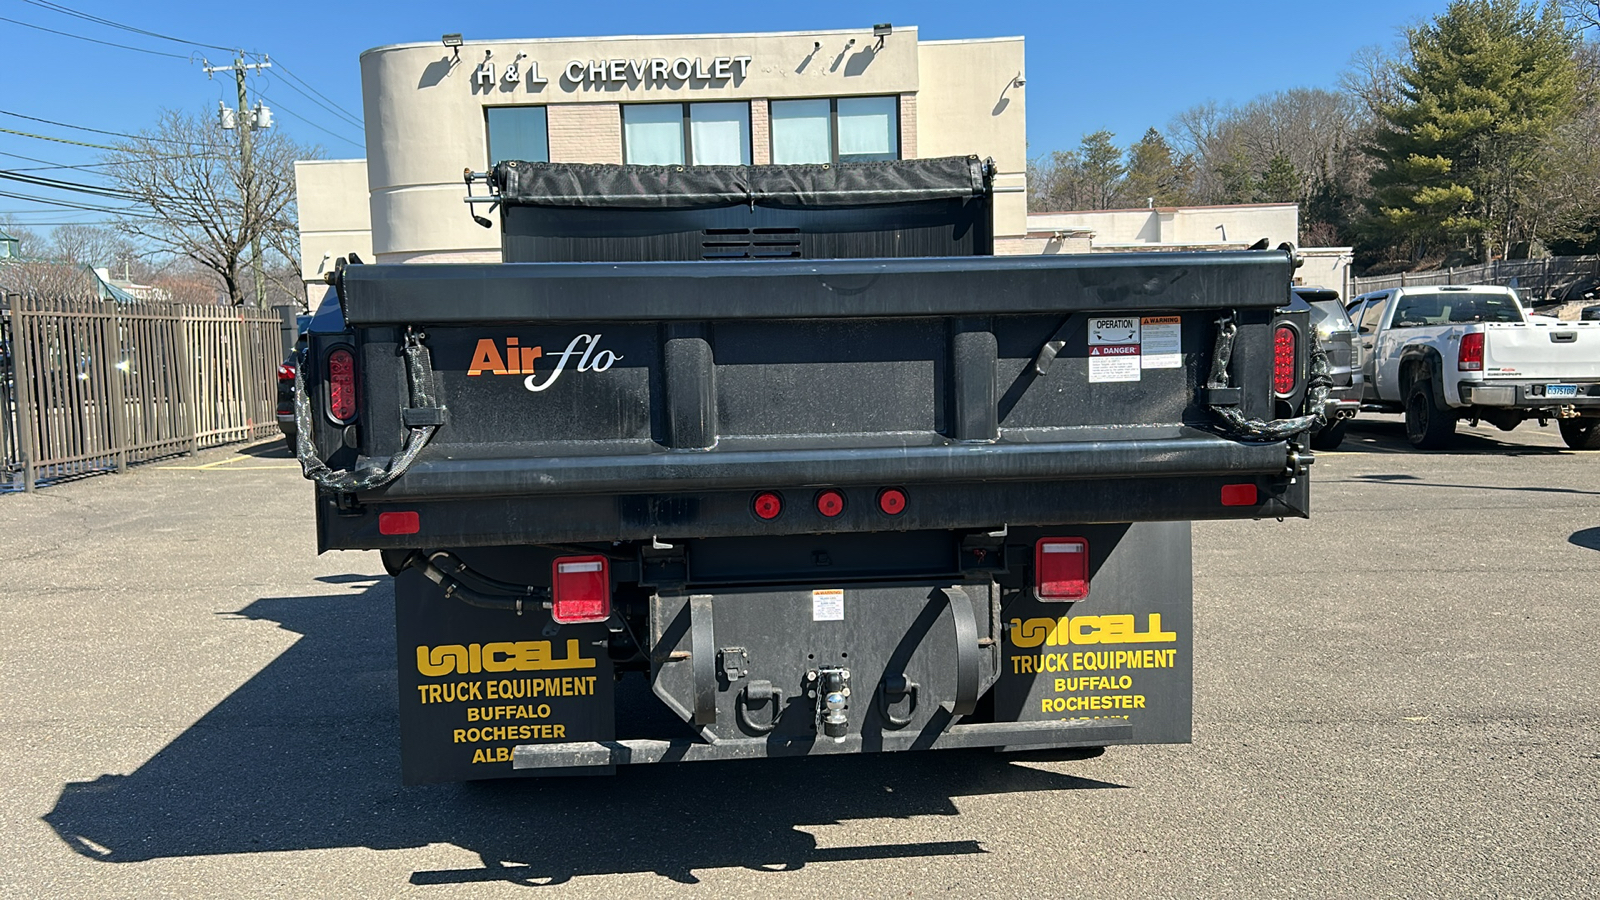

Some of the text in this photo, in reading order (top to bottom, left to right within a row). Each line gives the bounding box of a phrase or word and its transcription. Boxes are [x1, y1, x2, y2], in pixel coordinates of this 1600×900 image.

[477, 56, 751, 85] H & L CHEVROLET
[1096, 320, 1133, 329] OPERATION
[467, 333, 624, 392] Air flo
[1010, 613, 1177, 648] UNICELL
[416, 639, 596, 677] UNICELL
[1011, 649, 1177, 674] TRUCK EQUIPMENT
[418, 676, 597, 704] TRUCK EQUIPMENT
[1054, 675, 1132, 692] BUFFALO
[467, 704, 551, 722] BUFFALO
[1041, 695, 1145, 713] ROCHESTER
[453, 724, 566, 743] ROCHESTER
